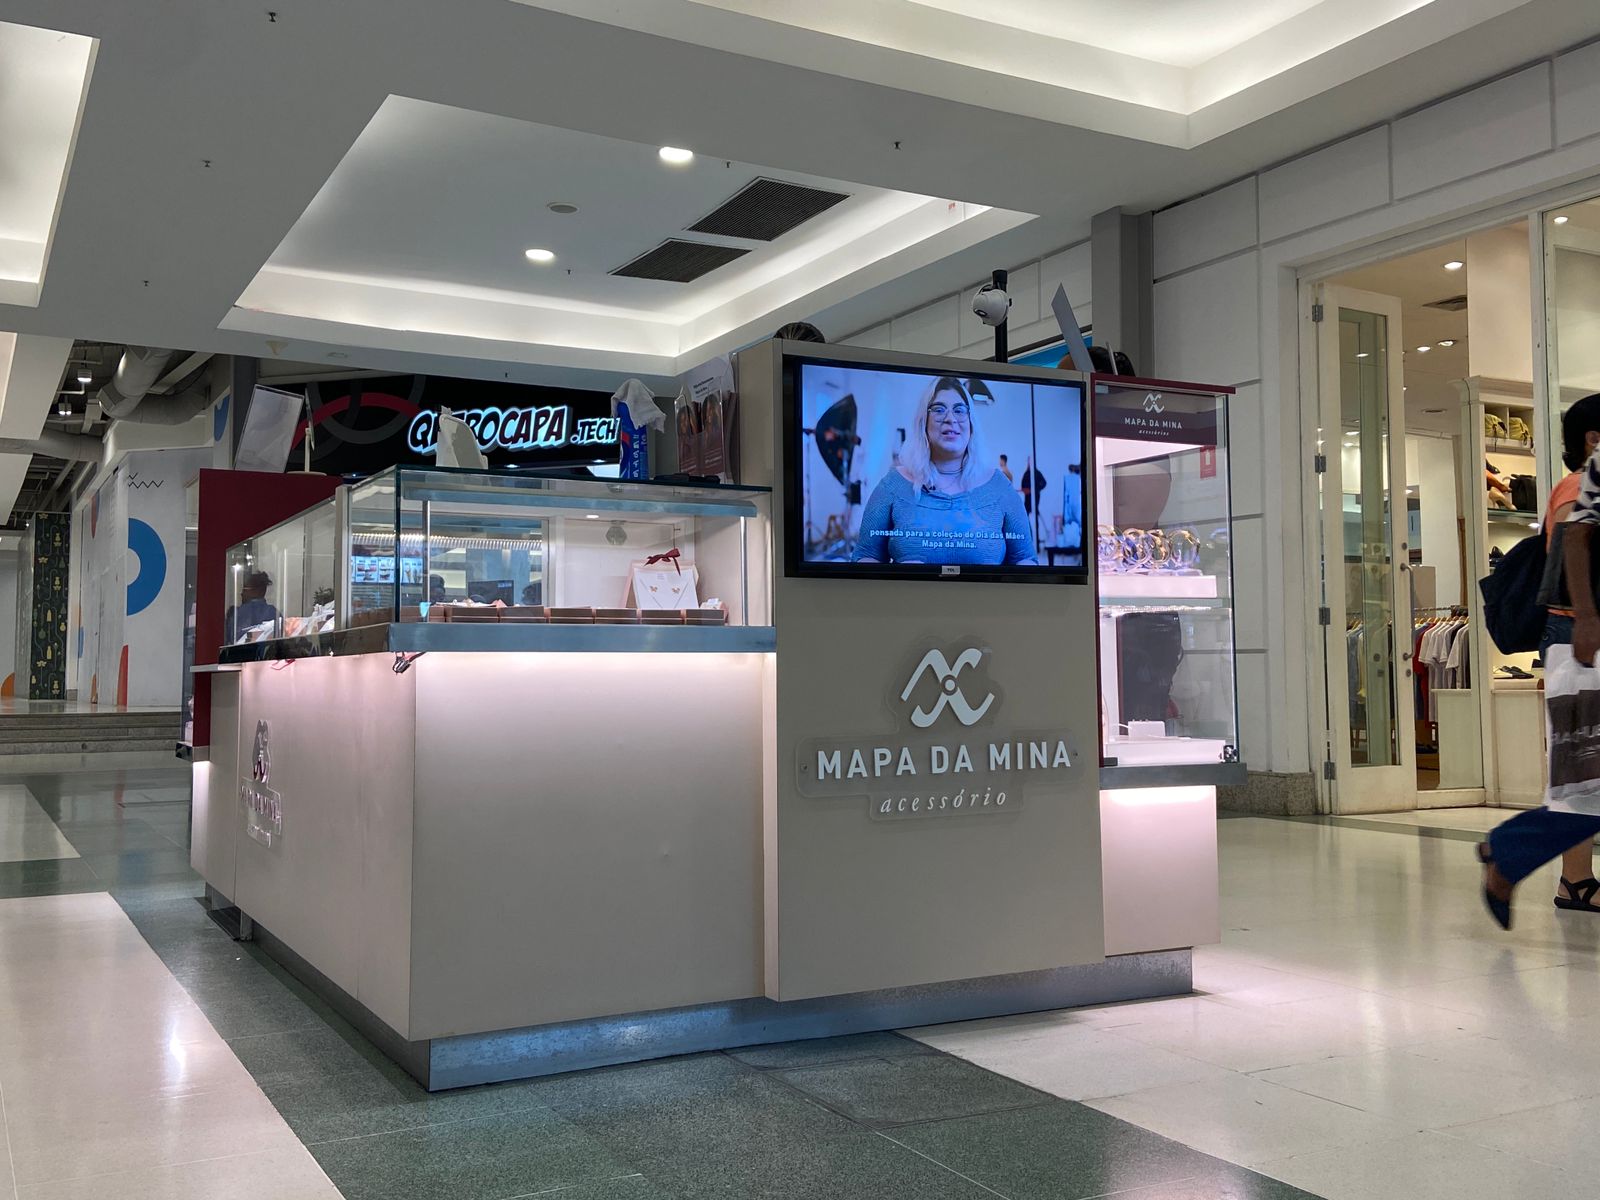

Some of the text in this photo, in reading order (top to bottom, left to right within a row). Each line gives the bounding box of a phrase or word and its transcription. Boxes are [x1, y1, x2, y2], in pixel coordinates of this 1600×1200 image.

[407, 405, 567, 453] QROCAPA
[1124, 417, 1182, 429] MAPA DA MINA
[869, 529, 903, 538] pensada
[932, 530, 963, 539] coleção
[964, 530, 974, 538] de
[990, 531, 1003, 539] das
[1005, 531, 1025, 540] Mães
[922, 540, 977, 549] Mapa da Mina.
[817, 740, 1071, 780] MAPA DA MINA
[880, 787, 1007, 813] acessório
